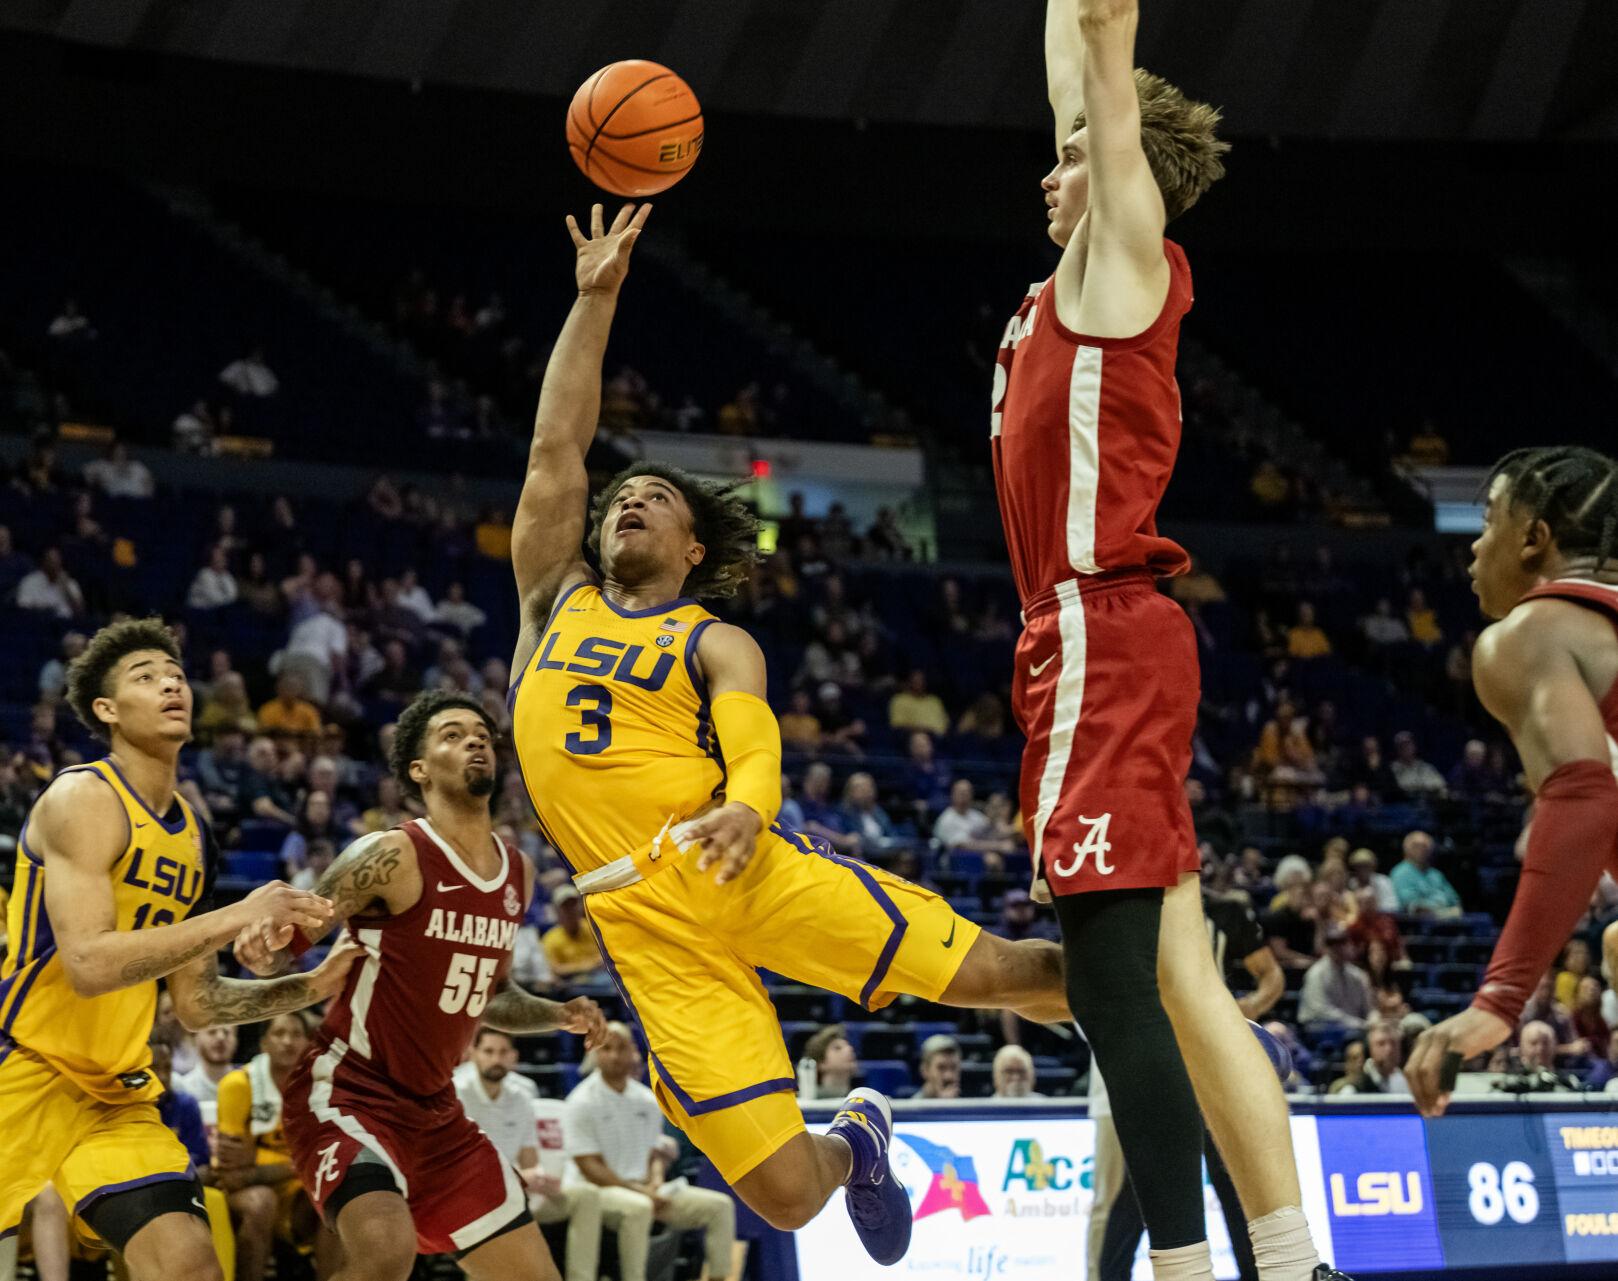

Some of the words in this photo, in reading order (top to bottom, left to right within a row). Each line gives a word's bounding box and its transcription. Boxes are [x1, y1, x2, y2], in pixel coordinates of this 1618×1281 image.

[535, 631, 677, 692] LSU
[564, 684, 613, 755] 3
[122, 847, 202, 906] LSU
[1053, 812, 1116, 878] A
[438, 952, 499, 1018] 55
[1329, 1171, 1424, 1217] LSU
[1468, 1161, 1540, 1226] 86
